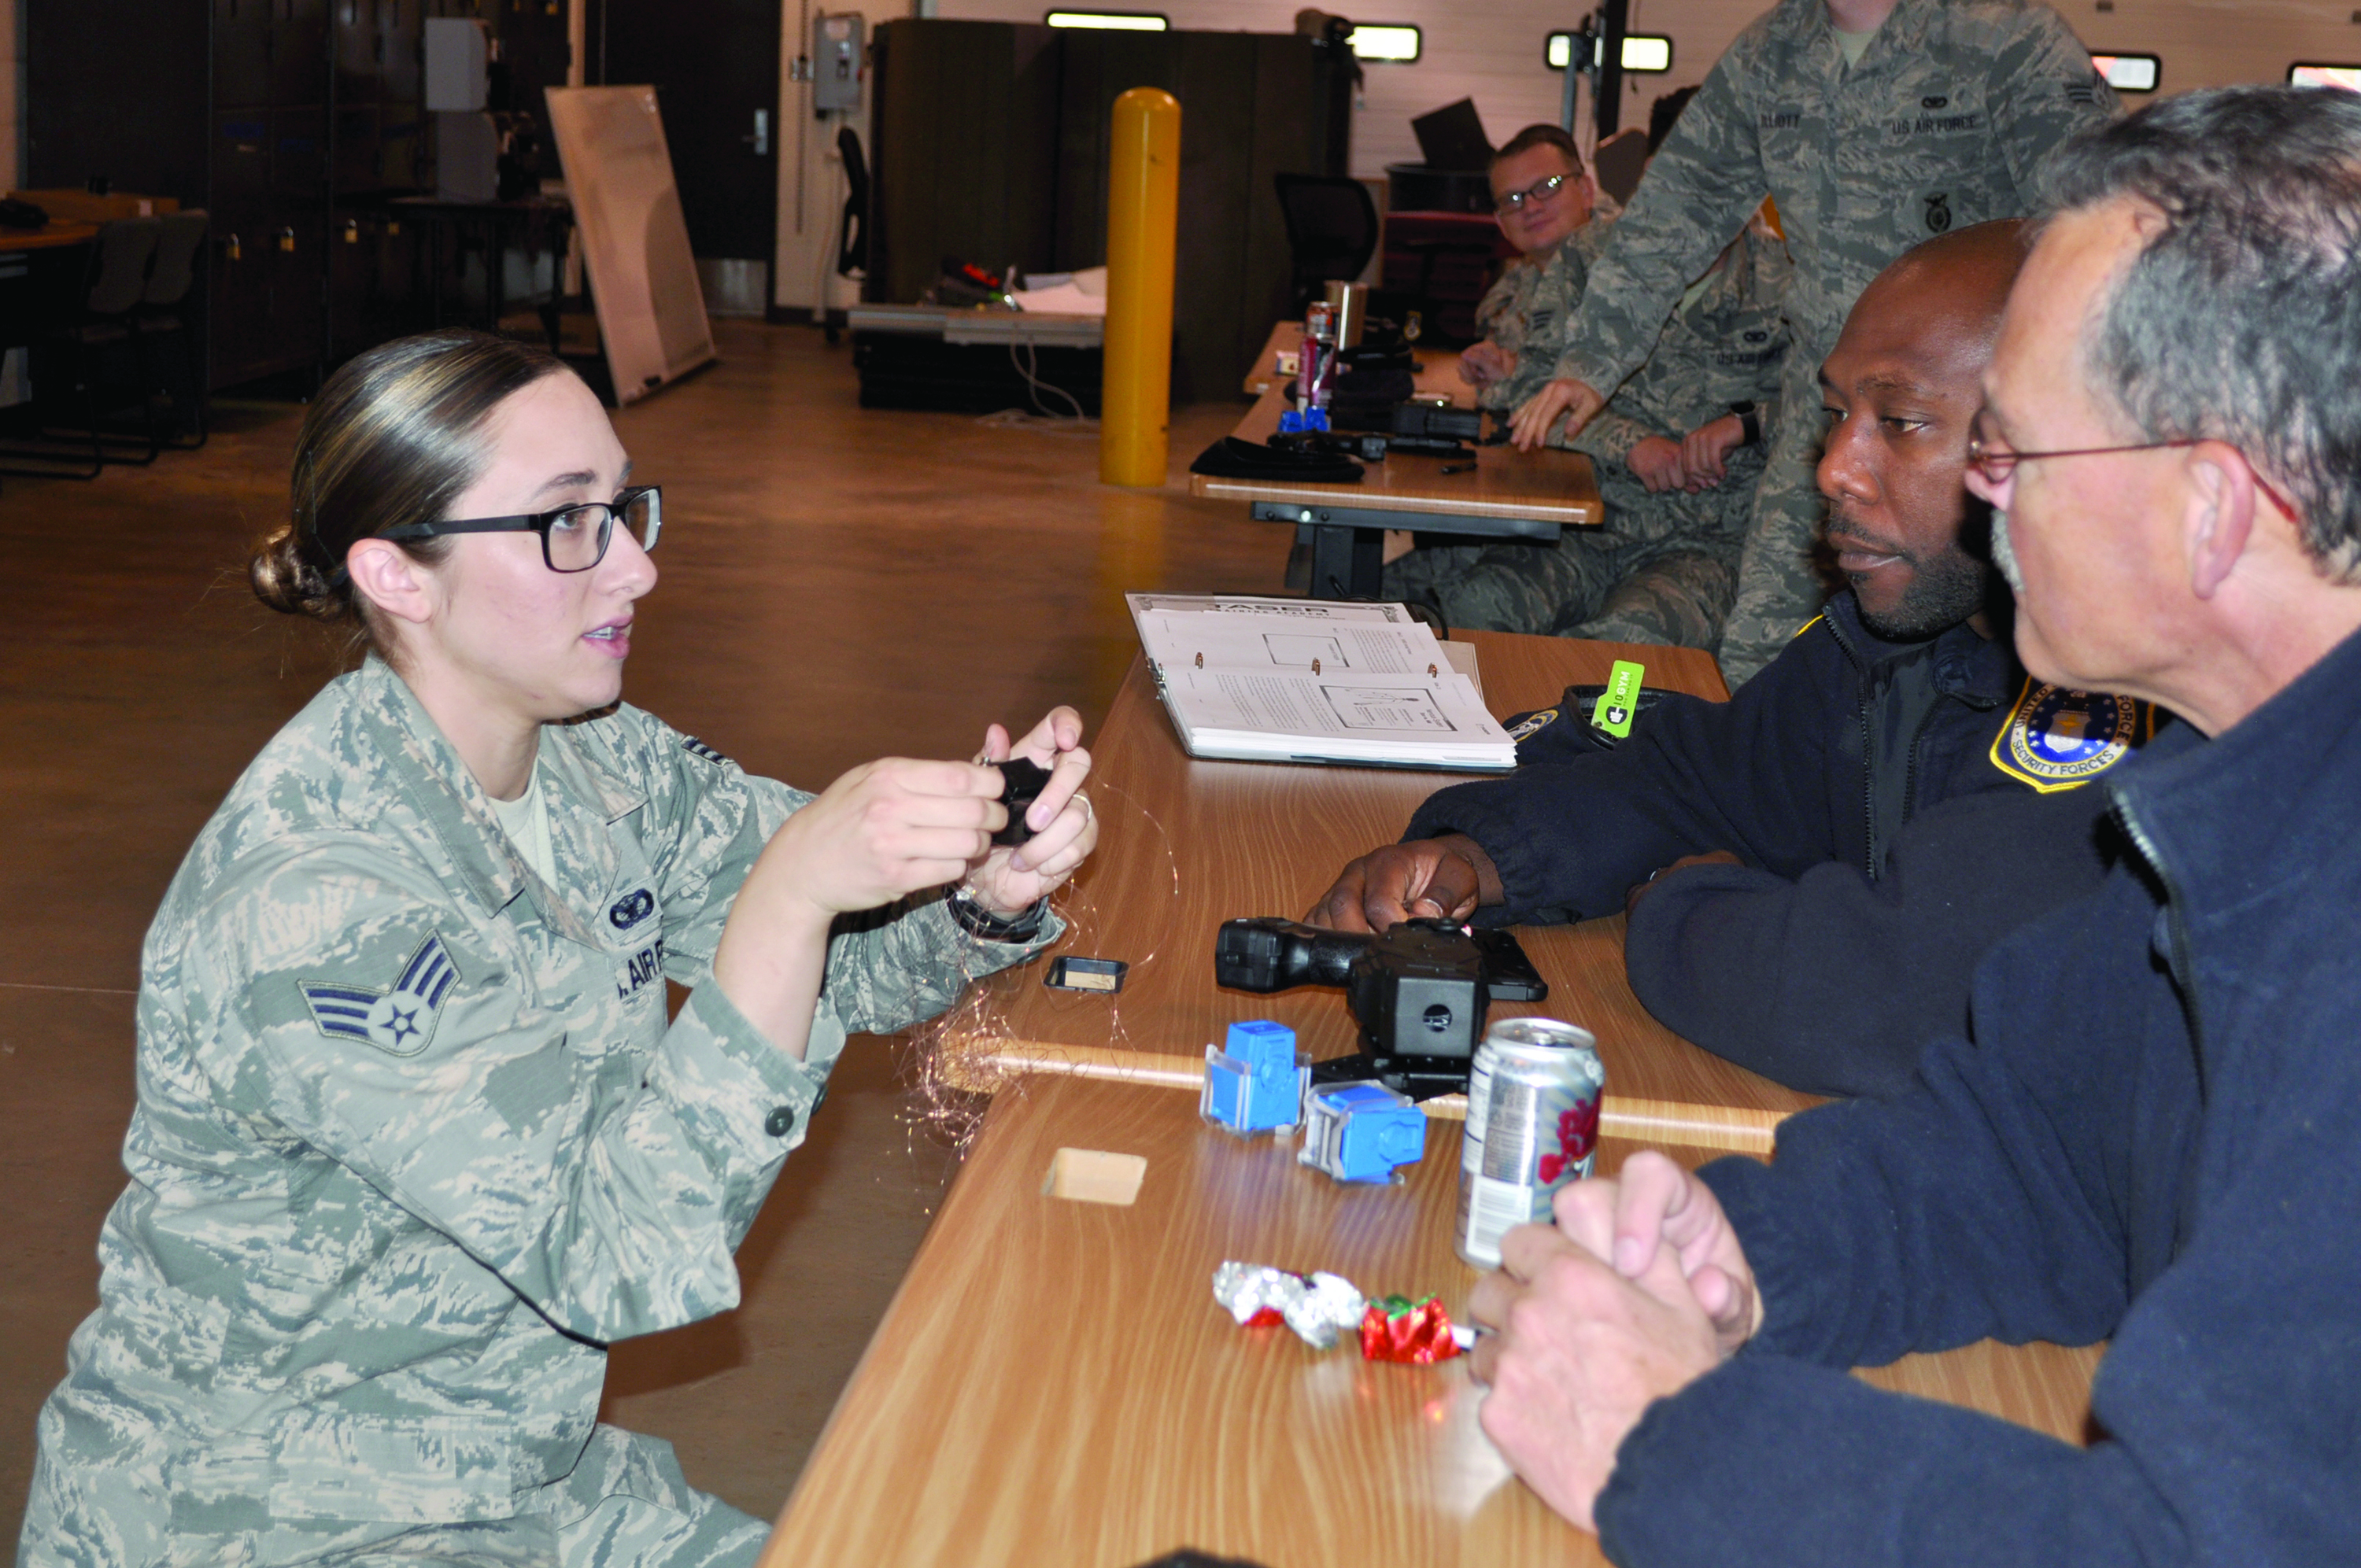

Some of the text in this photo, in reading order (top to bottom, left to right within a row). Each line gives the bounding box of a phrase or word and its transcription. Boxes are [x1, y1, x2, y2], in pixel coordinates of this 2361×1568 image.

[1915, 119, 1934, 134] AIR
[1937, 115, 1979, 132] FORCE
[2015, 688, 2049, 729] UNITED
[2116, 695, 2134, 740] FORCE
[2012, 739, 2115, 775] SECURITY FORCES
[628, 948, 657, 991] AIR
